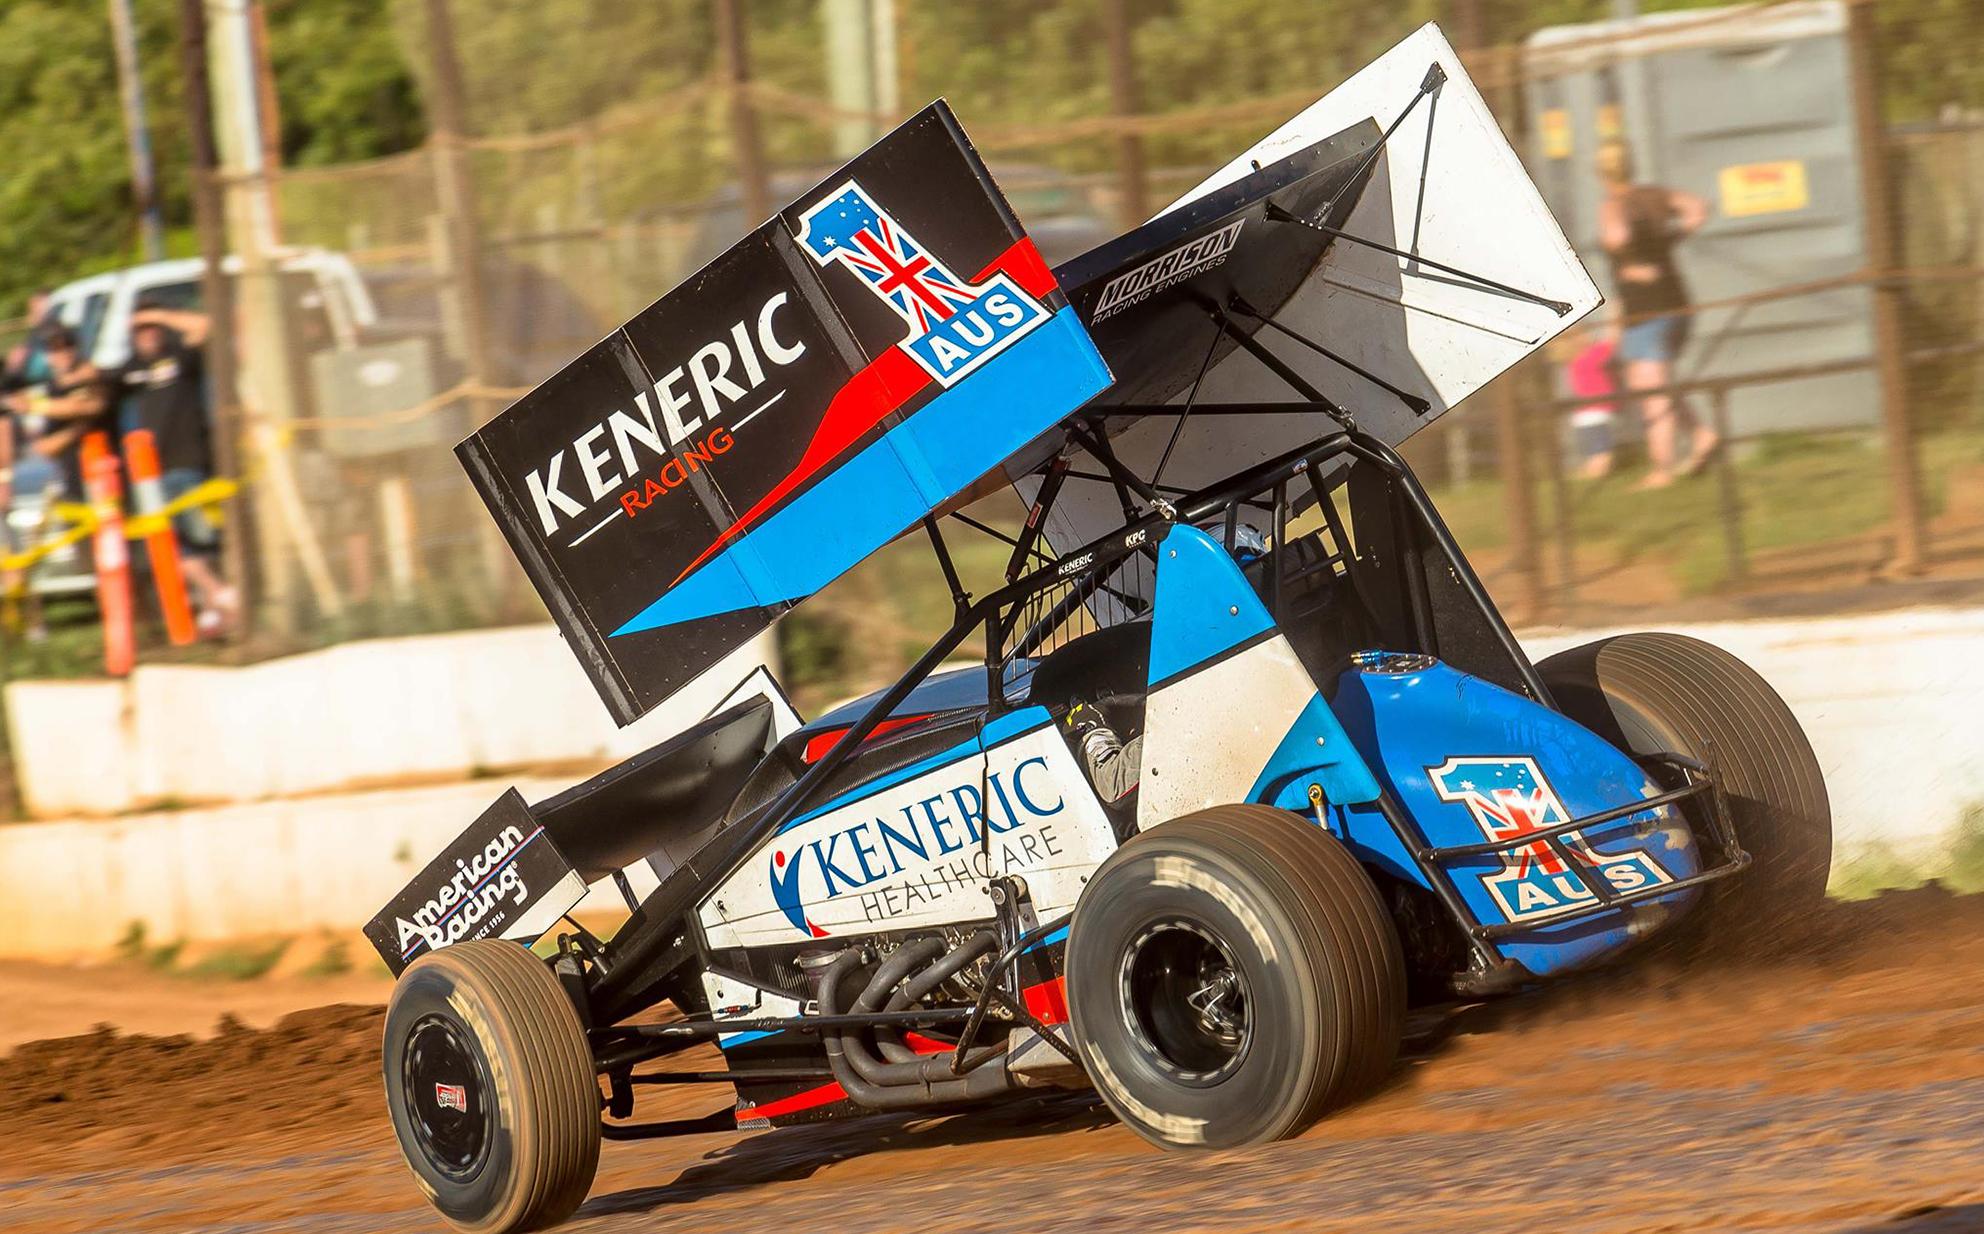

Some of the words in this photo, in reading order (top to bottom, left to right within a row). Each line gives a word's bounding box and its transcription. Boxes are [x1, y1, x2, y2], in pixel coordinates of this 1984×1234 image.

[1091, 288, 1151, 327] RACING
[1155, 254, 1227, 293] ENGINES
[1096, 219, 1243, 314] MORRISON
[928, 294, 1024, 372] AUS
[525, 291, 806, 536] KENERIC
[619, 427, 735, 518] RACING
[1058, 552, 1093, 575] KENERIC
[807, 756, 1065, 900] KENERIC
[395, 825, 524, 953] American
[860, 825, 1063, 924] HEALTHCARE
[1517, 865, 1646, 911] AUS
[469, 925, 490, 942] INCE
[489, 911, 506, 929] 1956
